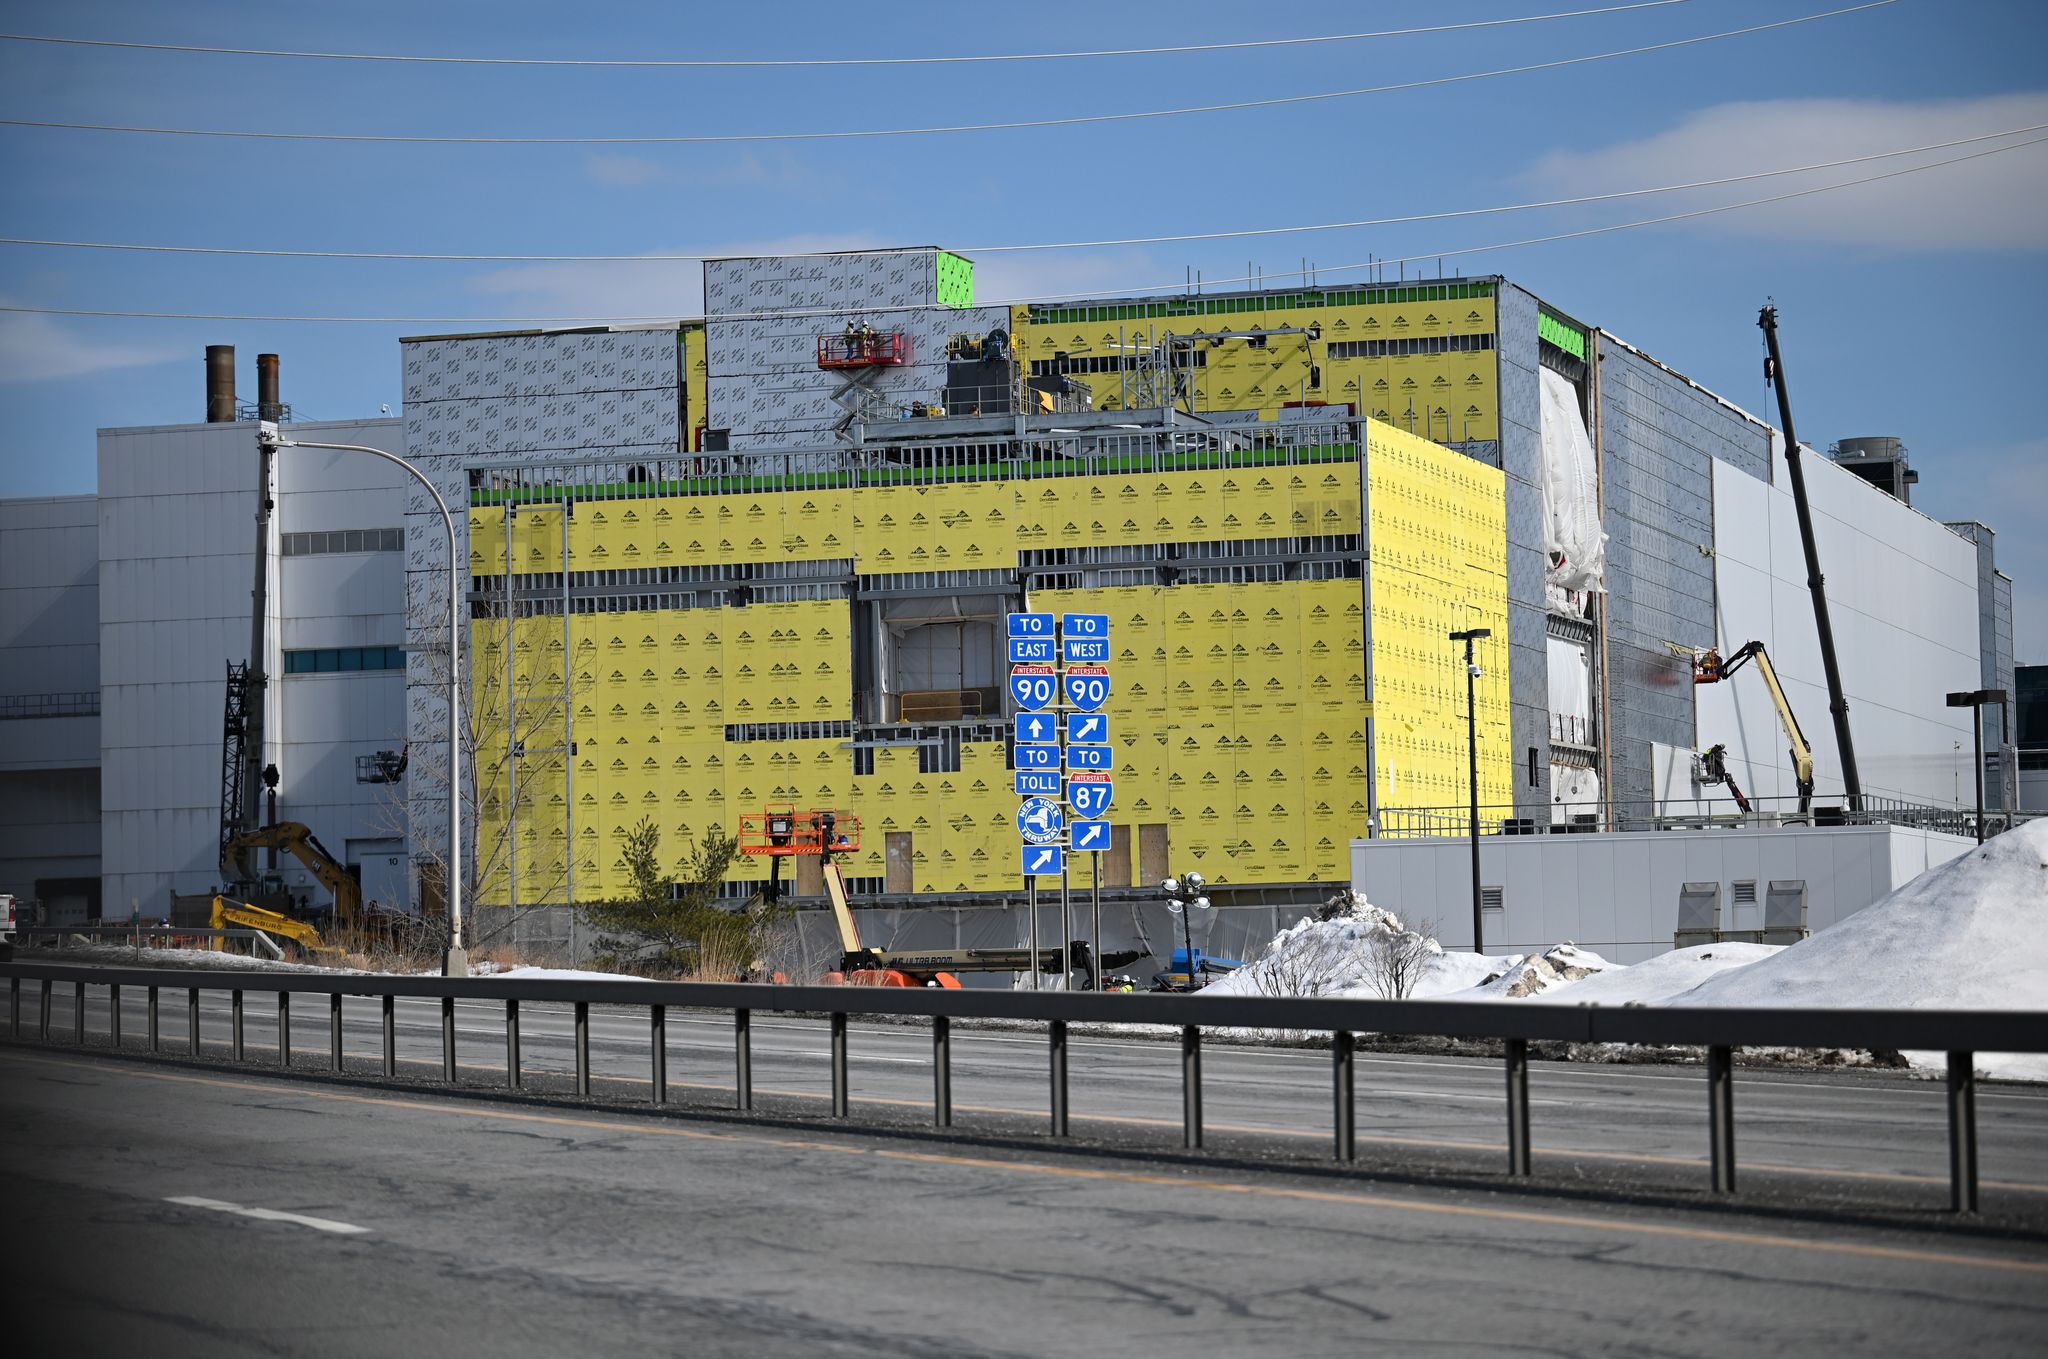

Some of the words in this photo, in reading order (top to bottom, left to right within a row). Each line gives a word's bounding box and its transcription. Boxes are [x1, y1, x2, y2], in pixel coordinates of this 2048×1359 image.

[1020, 618, 1042, 632] TO
[1074, 619, 1096, 632] TO
[1017, 642, 1047, 657] EAST
[1070, 642, 1102, 657] WEST
[1017, 679, 1050, 701] 90
[1072, 680, 1104, 702] 90
[1026, 750, 1048, 764] TO
[1078, 751, 1100, 764] TO
[1020, 776, 1056, 790] TOLL
[1076, 787, 1106, 809] 87
[1020, 801, 1034, 817] NEW
[1039, 799, 1060, 817] YORK
[1022, 826, 1059, 842] THRUWAY
[389, 858, 398, 866] 10
